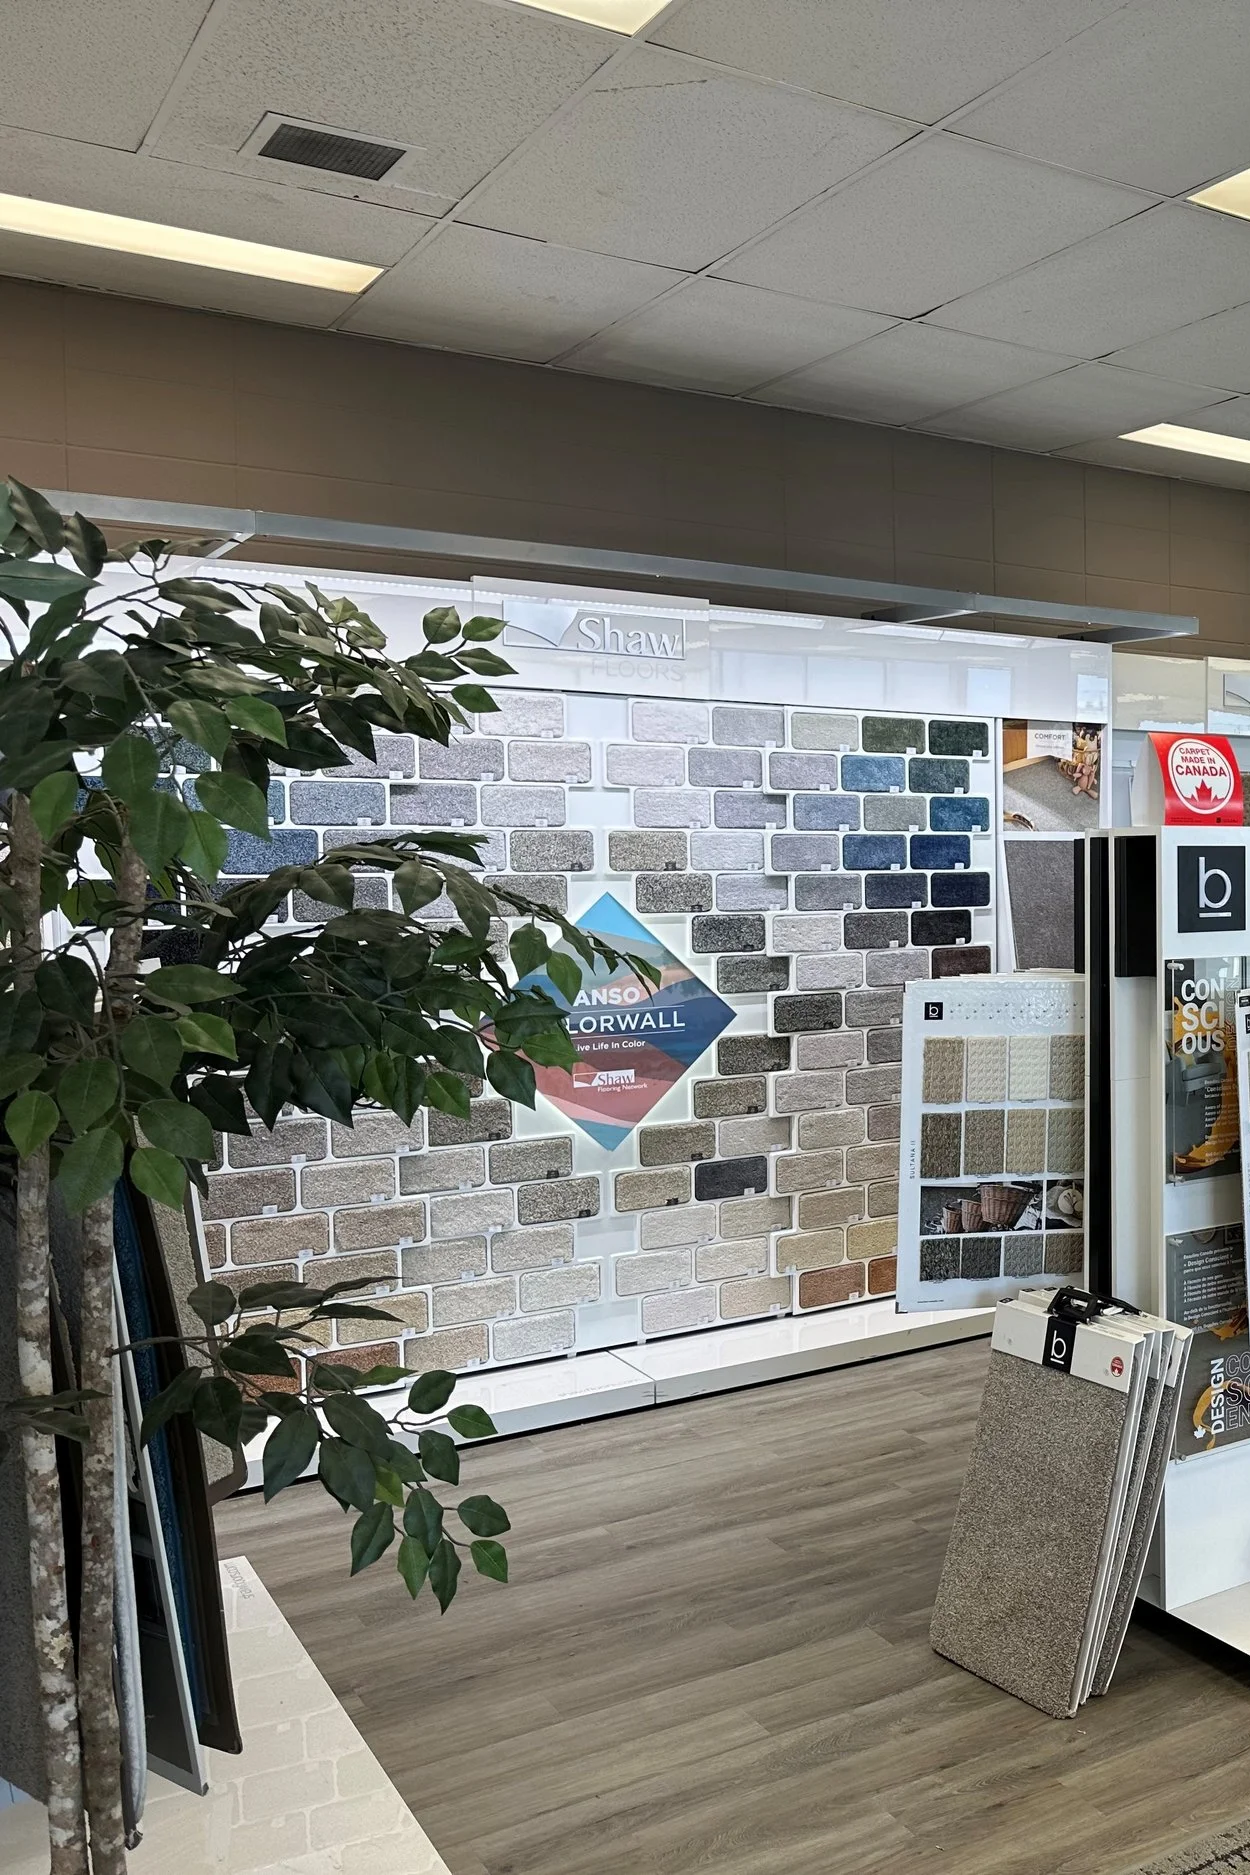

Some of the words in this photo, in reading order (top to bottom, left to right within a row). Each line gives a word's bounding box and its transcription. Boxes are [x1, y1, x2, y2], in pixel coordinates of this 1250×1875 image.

[578, 617, 680, 657] Shaw
[591, 658, 683, 682] FLOORS
[1034, 733, 1066, 741] COMFORT
[1179, 747, 1210, 756] CARPET
[1180, 755, 1205, 764] MADE
[1175, 764, 1227, 777] CANADA
[573, 986, 640, 1007] ANSO
[1181, 978, 1224, 1001] CON
[566, 1010, 686, 1035] LORWALL
[1182, 1001, 1224, 1031] SCI
[592, 1041, 610, 1051] Life
[611, 1041, 620, 1050] In
[622, 1039, 646, 1049] Color
[1182, 1030, 1225, 1054] OUS
[598, 1073, 635, 1086] Shaw
[598, 1085, 622, 1093] Flooring
[622, 1082, 648, 1090] Network
[1211, 1358, 1225, 1434] DESIGN
